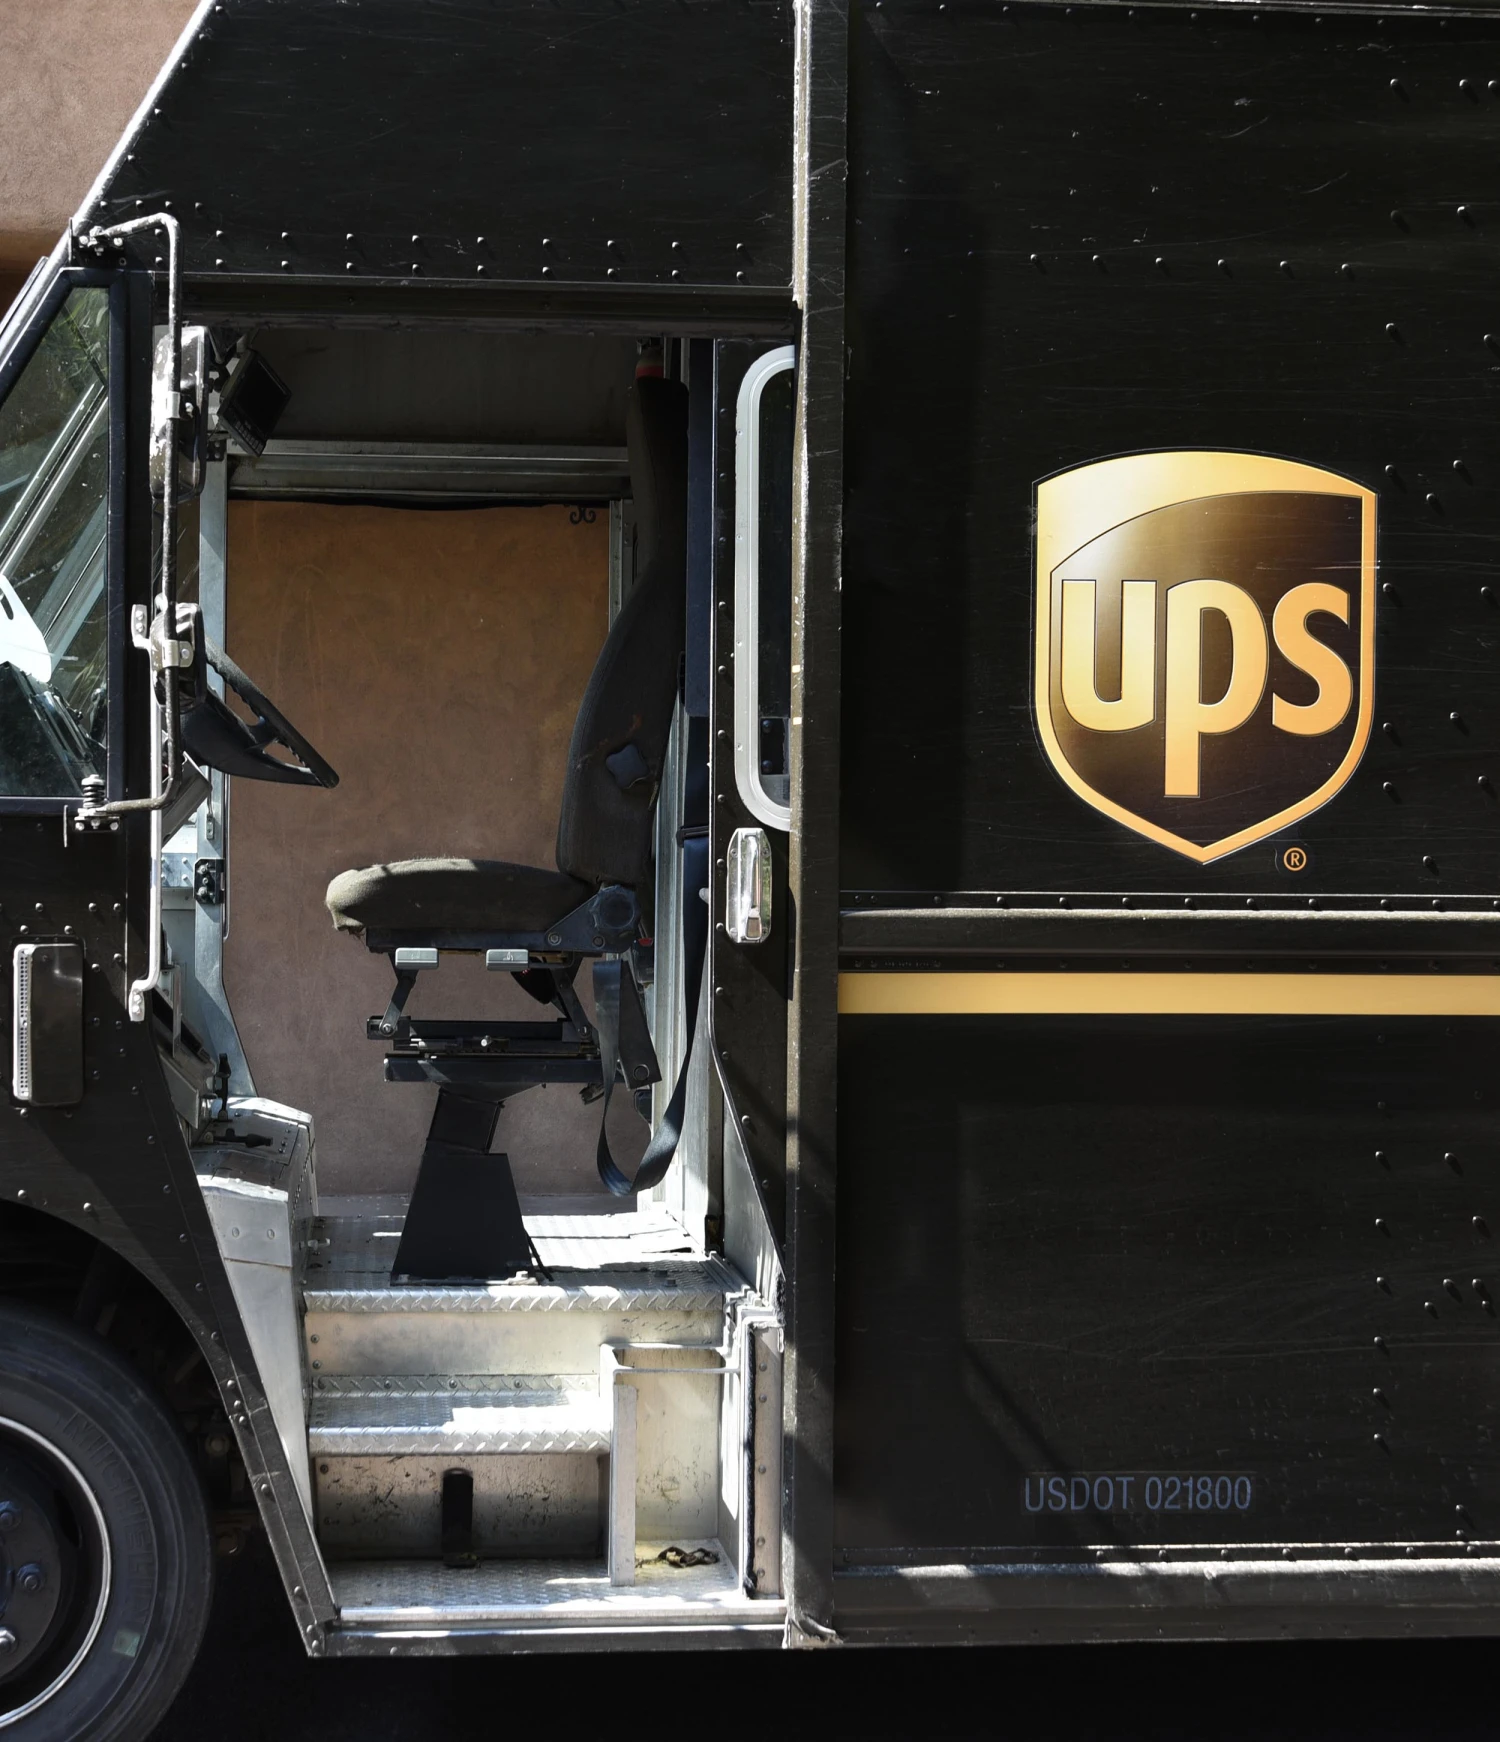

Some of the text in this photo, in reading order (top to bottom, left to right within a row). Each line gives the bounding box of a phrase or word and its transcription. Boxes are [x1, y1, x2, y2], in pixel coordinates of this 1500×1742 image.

[1061, 579, 1353, 797] ups
[1024, 1476, 1251, 1512] USDOT 021800
